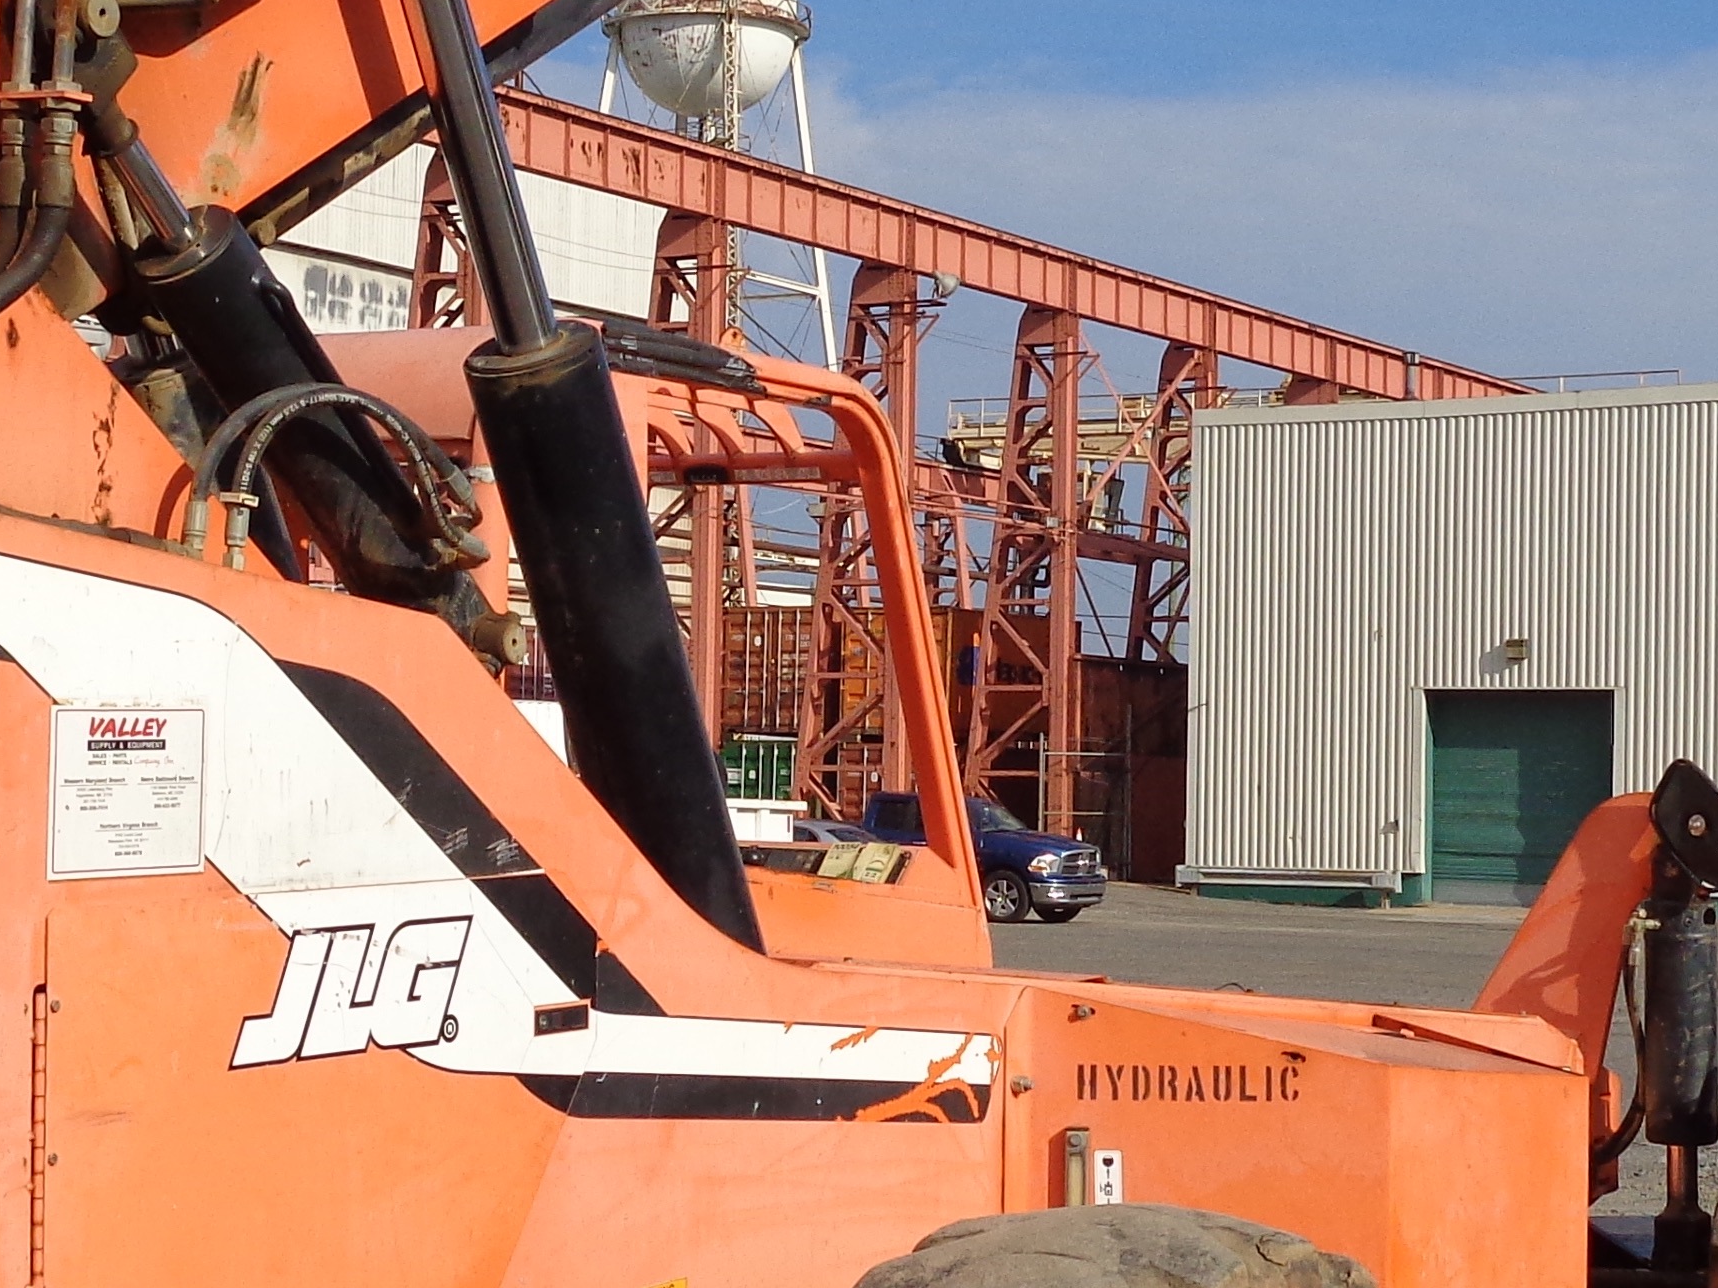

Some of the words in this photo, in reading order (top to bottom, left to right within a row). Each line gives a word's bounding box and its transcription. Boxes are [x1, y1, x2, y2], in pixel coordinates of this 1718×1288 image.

[88, 716, 167, 738] VALLEY
[90, 741, 116, 750] SUPPLY
[127, 740, 164, 750] EQUIPMENT
[228, 915, 473, 1071] JLG
[1075, 1063, 1301, 1103] HYDRAULIC
